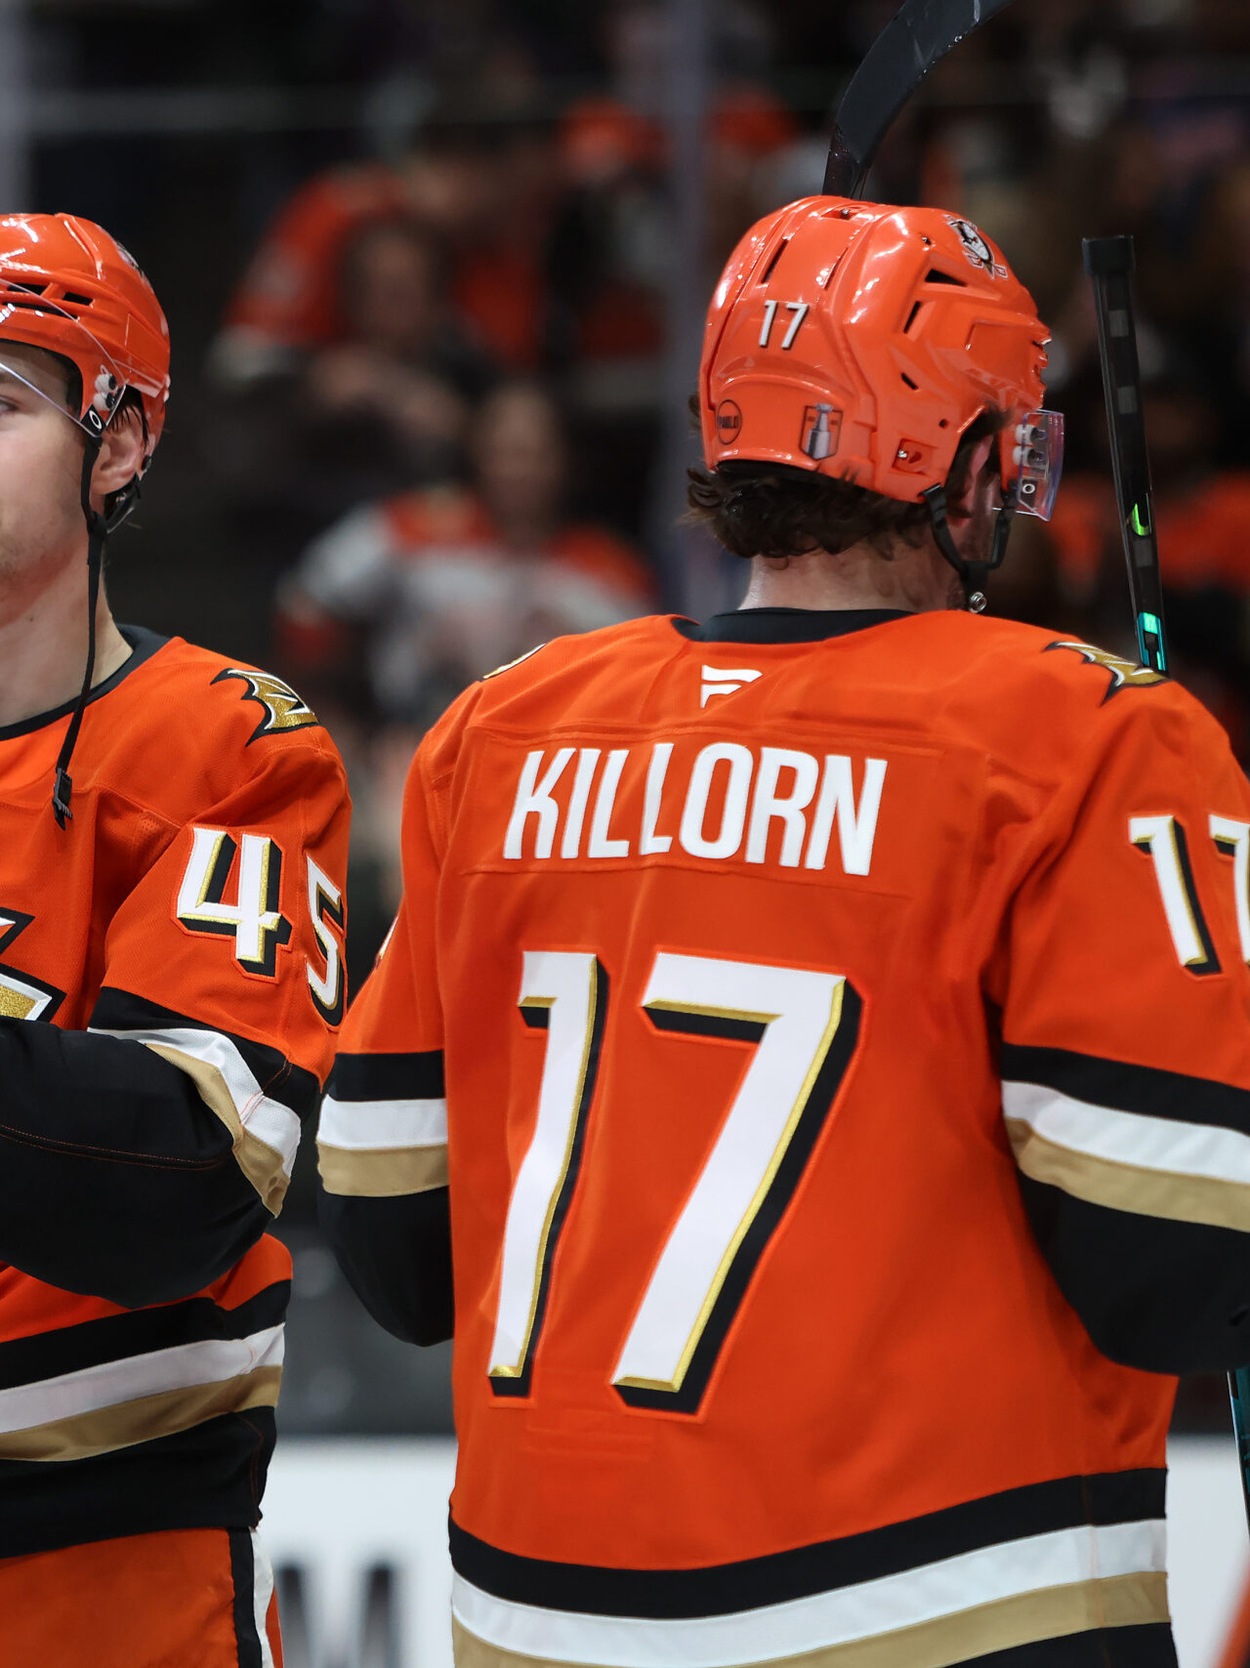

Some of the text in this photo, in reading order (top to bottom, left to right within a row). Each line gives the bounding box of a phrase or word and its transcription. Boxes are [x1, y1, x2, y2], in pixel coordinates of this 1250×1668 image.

[758, 299, 809, 351] 17
[502, 742, 888, 876] KILLORN
[177, 827, 345, 1027] 45
[488, 950, 865, 1416] 17
